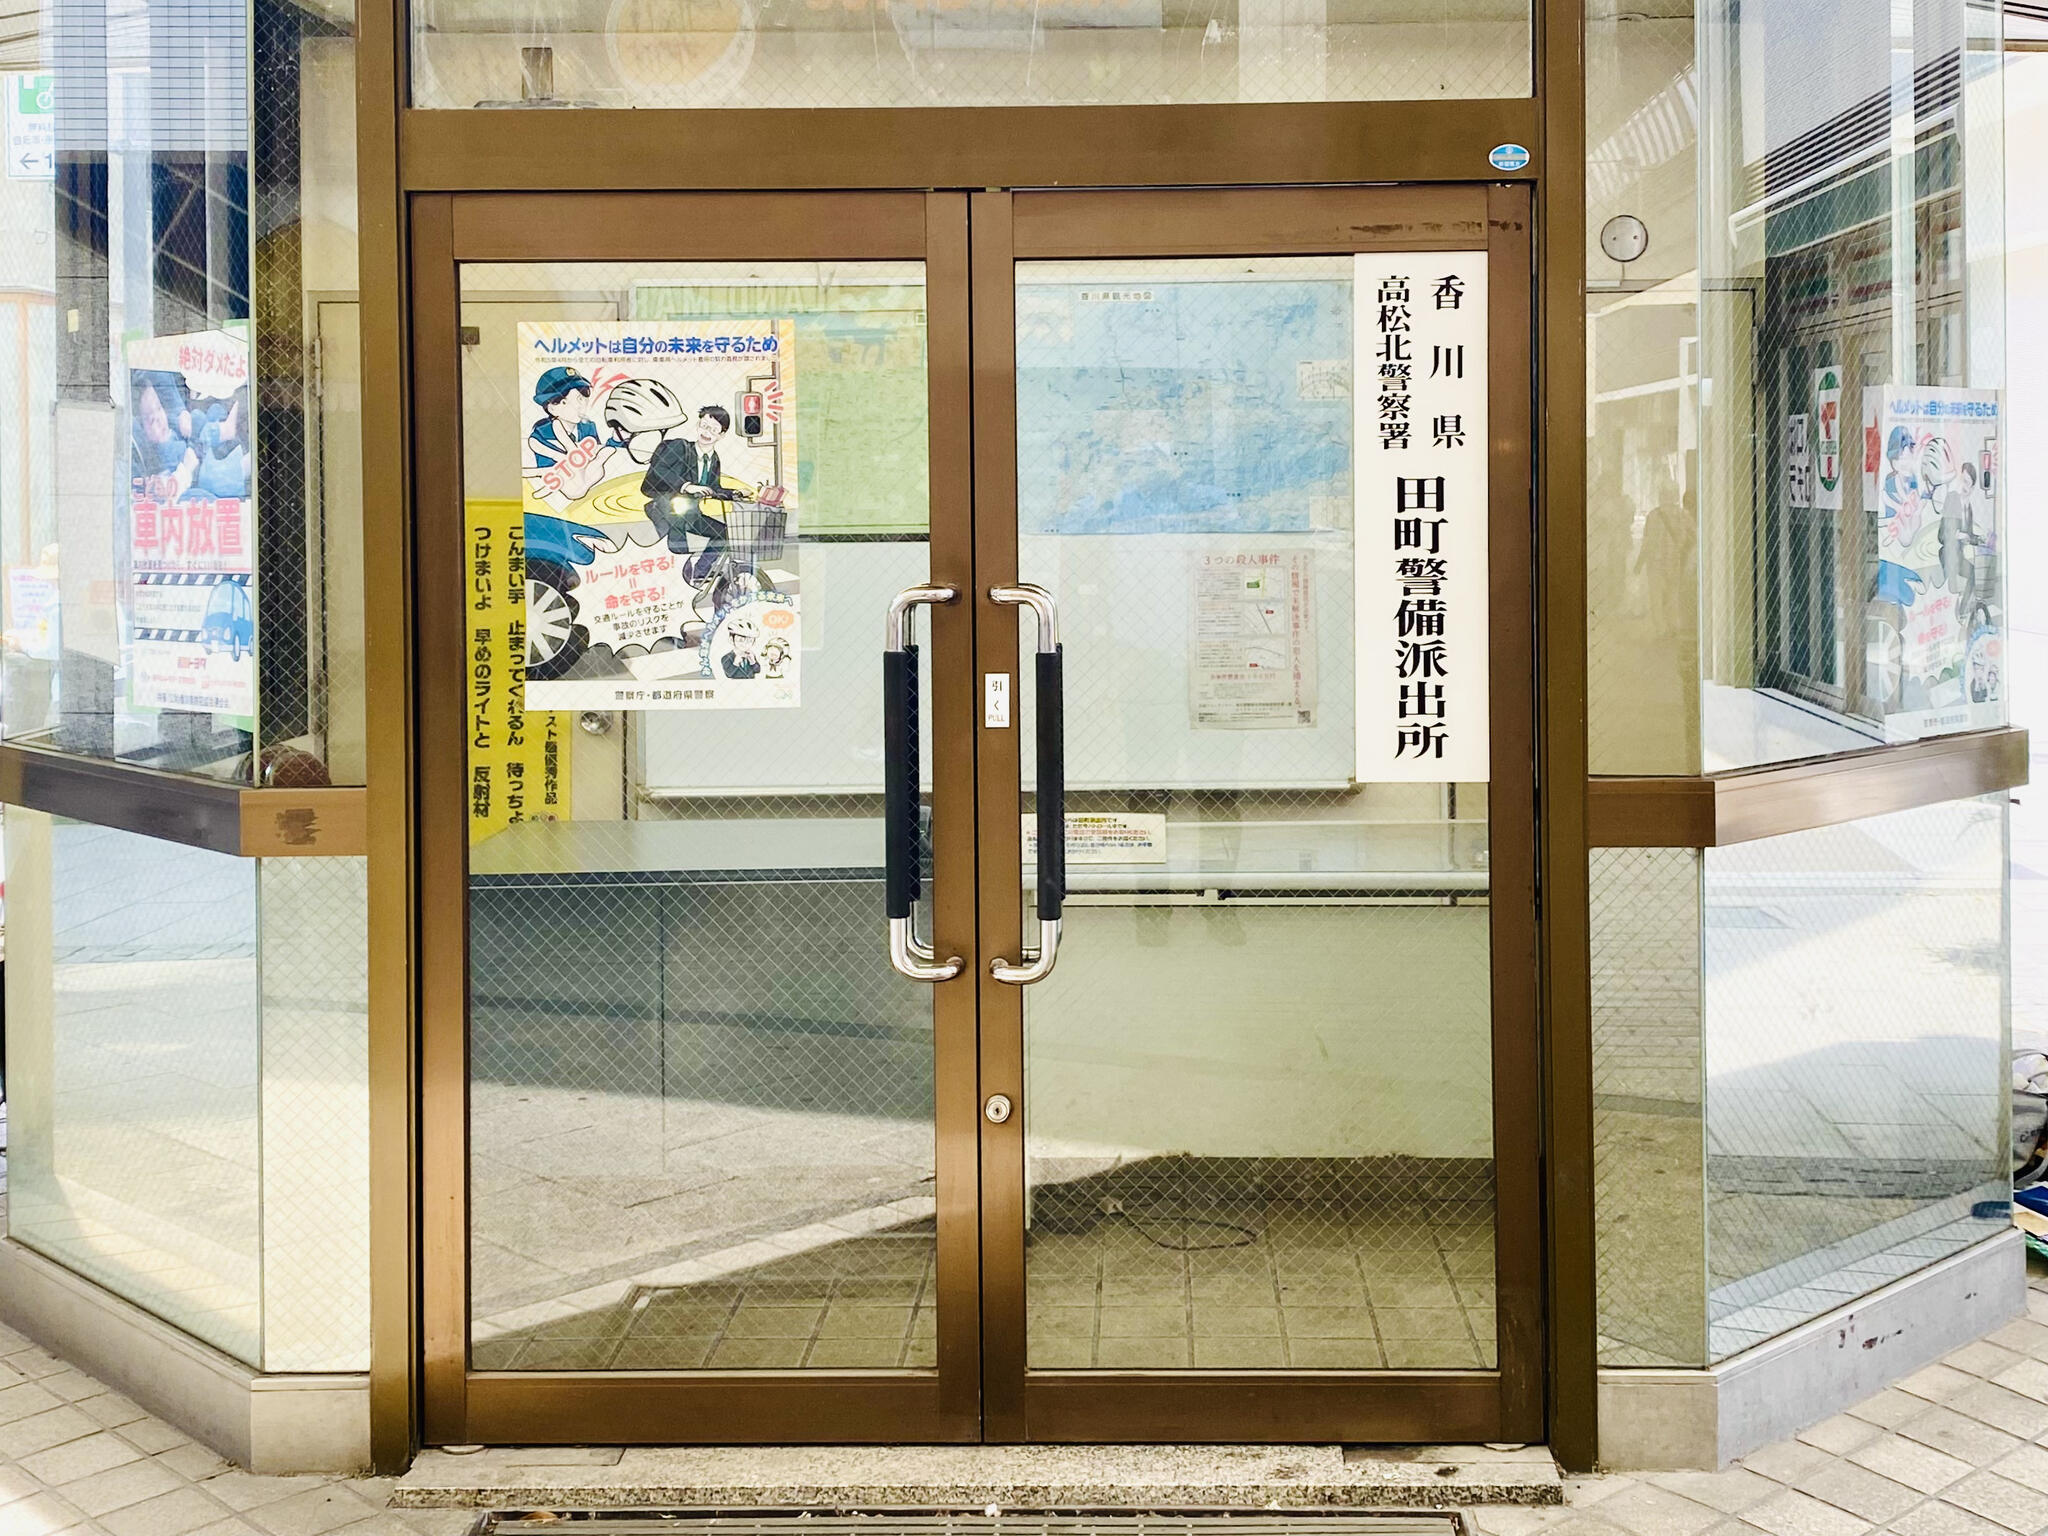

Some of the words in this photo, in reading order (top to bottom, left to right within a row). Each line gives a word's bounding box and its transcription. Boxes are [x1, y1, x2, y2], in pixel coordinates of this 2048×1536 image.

[534, 336, 779, 355] ヘルメットは自分の未来を守るため
[1376, 275, 1412, 450] 高松北警察署
[1429, 275, 1466, 450] 香川県
[543, 438, 596, 490] STOP
[133, 497, 243, 558] 車内放置
[474, 527, 491, 611] つけまいよ
[594, 600, 684, 625] 交通ルールを守ることが
[613, 613, 669, 632] 事故のリスクを
[1393, 476, 1449, 759] 田町警備派出所
[474, 628, 491, 748] 早めのライトと
[615, 690, 714, 700] 警察庁・都道府県警察
[992, 680, 1003, 711] 引く
[473, 766, 491, 818] 反射材
